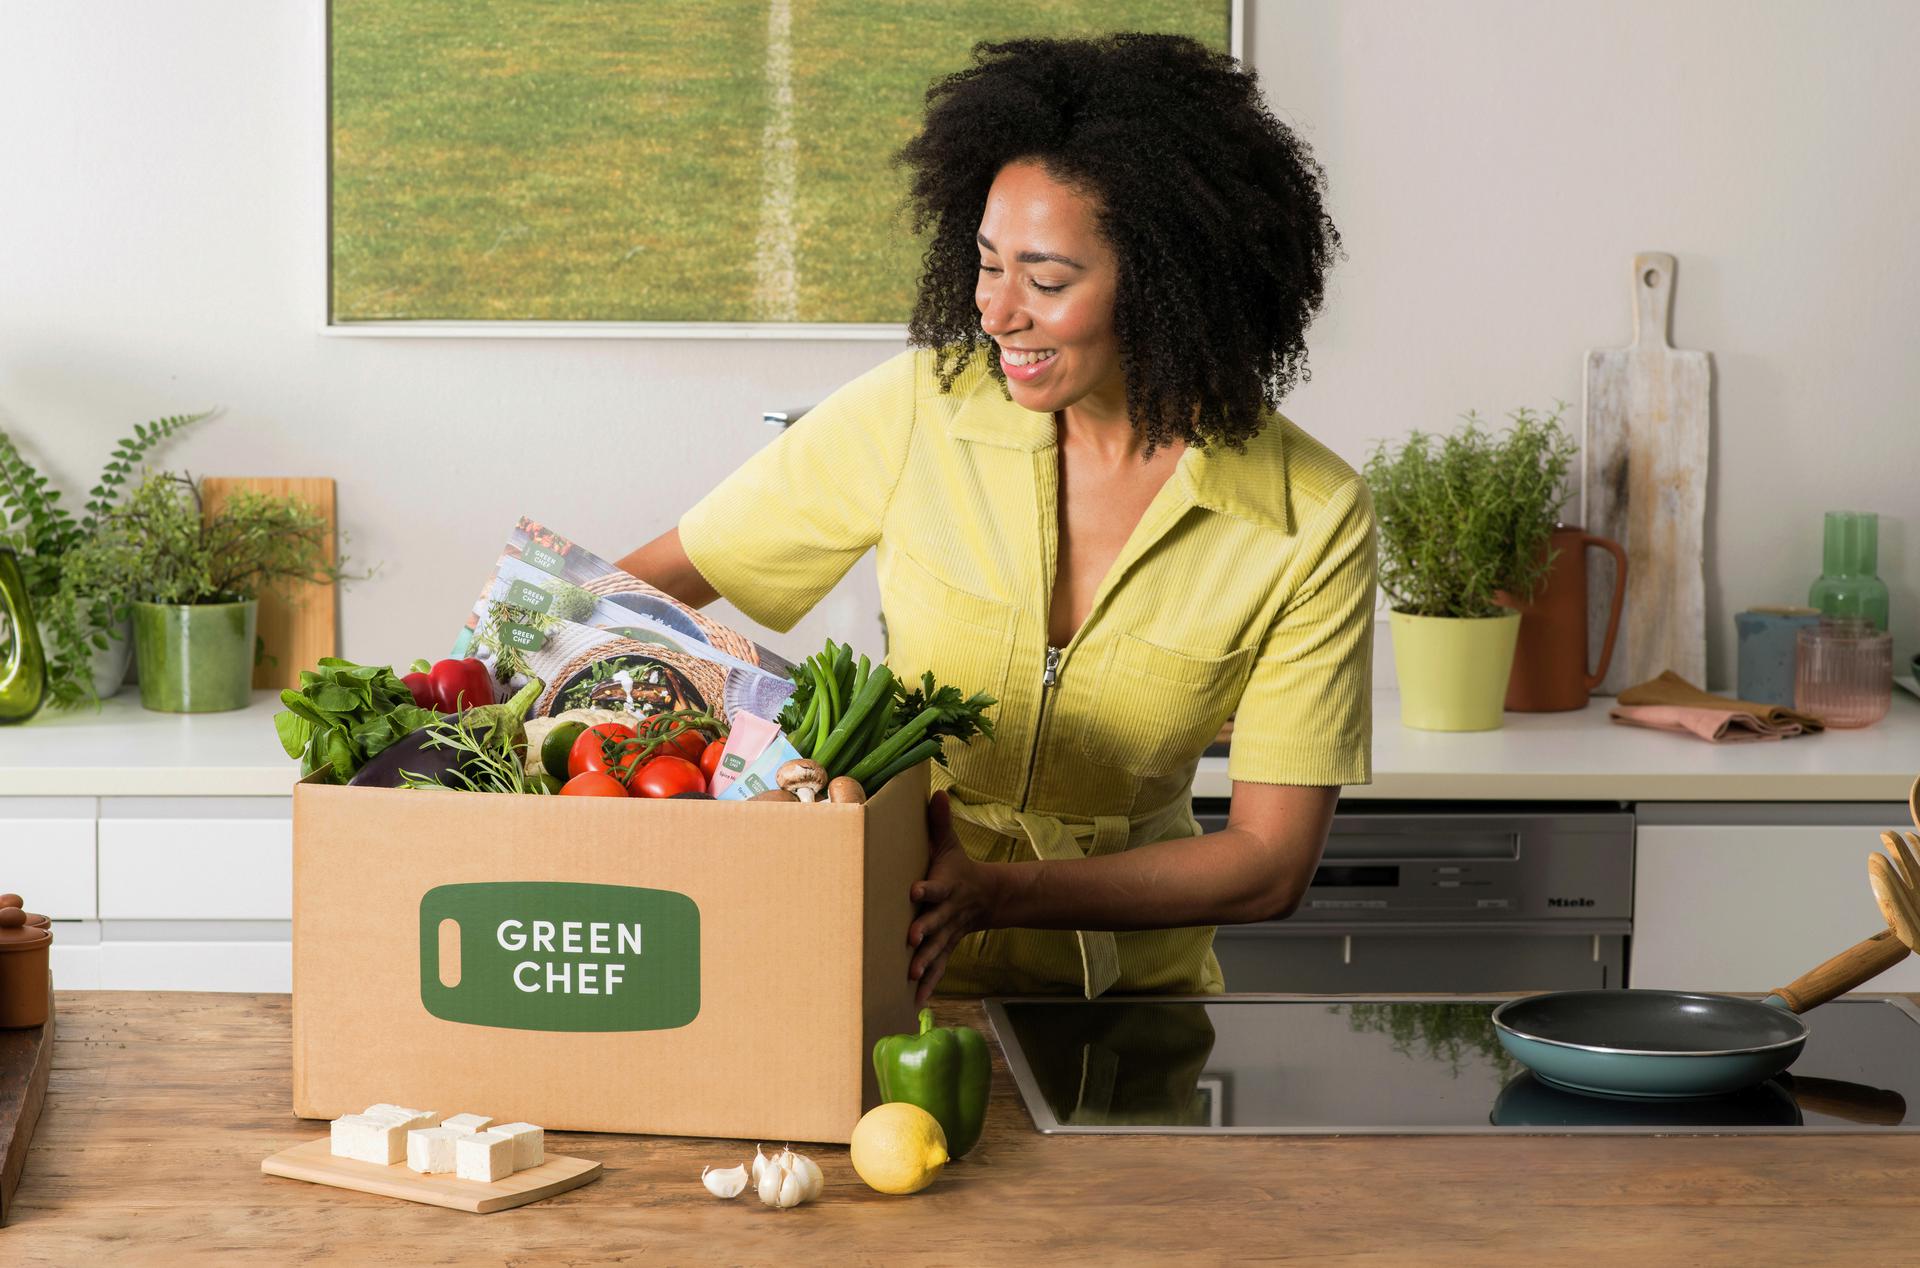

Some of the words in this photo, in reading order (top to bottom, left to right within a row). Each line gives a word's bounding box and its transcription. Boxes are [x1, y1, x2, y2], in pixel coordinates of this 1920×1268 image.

[535, 550, 557, 565] GREEN
[522, 588, 545, 601] GREEN
[522, 595, 540, 605] CHEF
[512, 629, 535, 640] GREEN
[512, 635, 531, 645] CHEF
[1548, 897, 1595, 908] Miele
[496, 919, 642, 955] GREEN
[513, 961, 626, 995] CHEF
